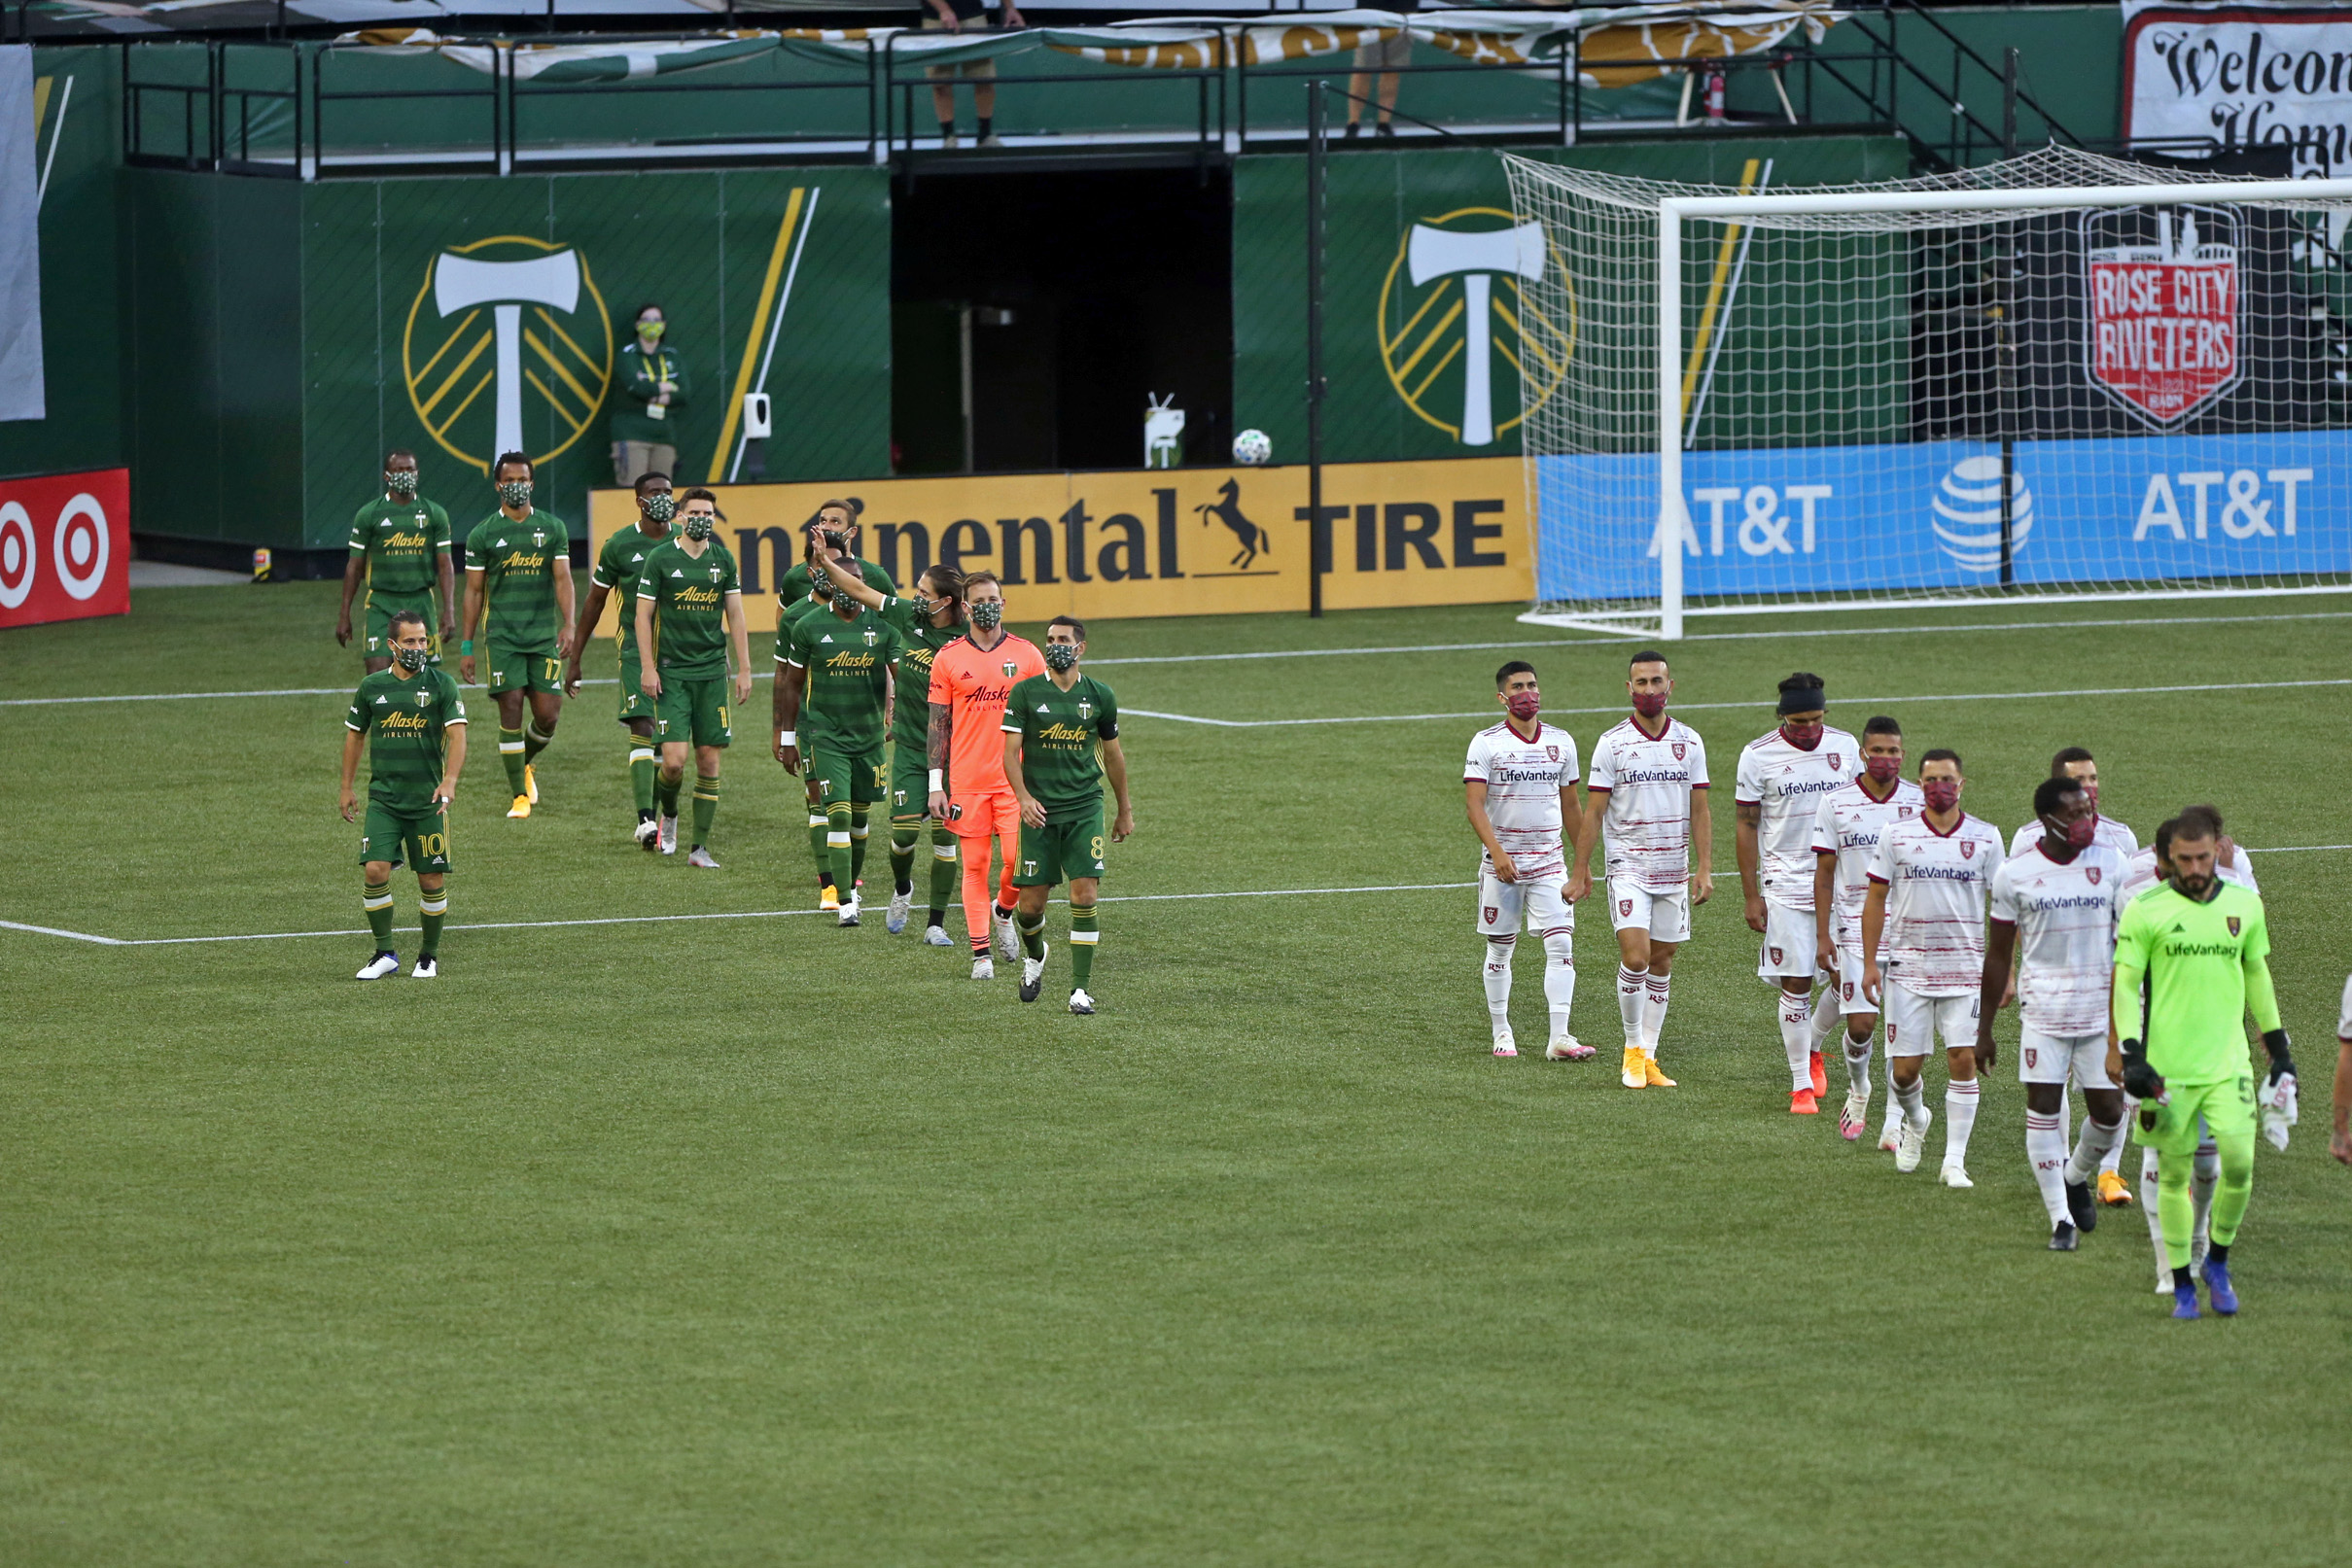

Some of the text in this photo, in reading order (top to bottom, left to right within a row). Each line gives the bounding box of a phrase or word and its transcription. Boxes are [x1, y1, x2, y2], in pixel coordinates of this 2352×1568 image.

[2096, 268, 2230, 318] ROSE CITY
[2098, 316, 2231, 372] RIVETERS
[2132, 468, 2314, 540] AT&T
[383, 532, 426, 548] Alaska
[1294, 499, 1506, 574] TIRE
[502, 551, 544, 568] Alaska
[674, 585, 720, 604] Alaska
[826, 650, 875, 669] Alaska
[544, 658, 562, 681] 17
[380, 711, 428, 730] Alaska
[1039, 722, 1087, 743] Alaska
[1624, 769, 1689, 784] LifeVantage
[418, 832, 445, 857] 10
[1090, 836, 1105, 860] 8
[1905, 866, 1975, 882] LifeVantage
[2028, 895, 2106, 913] LifeVantage
[2165, 941, 2237, 958] LifeVantag
[1488, 963, 1507, 973] RSL
[1622, 986, 1641, 994] RSL
[1785, 1013, 1808, 1023] RSL
[2038, 1160, 2061, 1170] RSL
